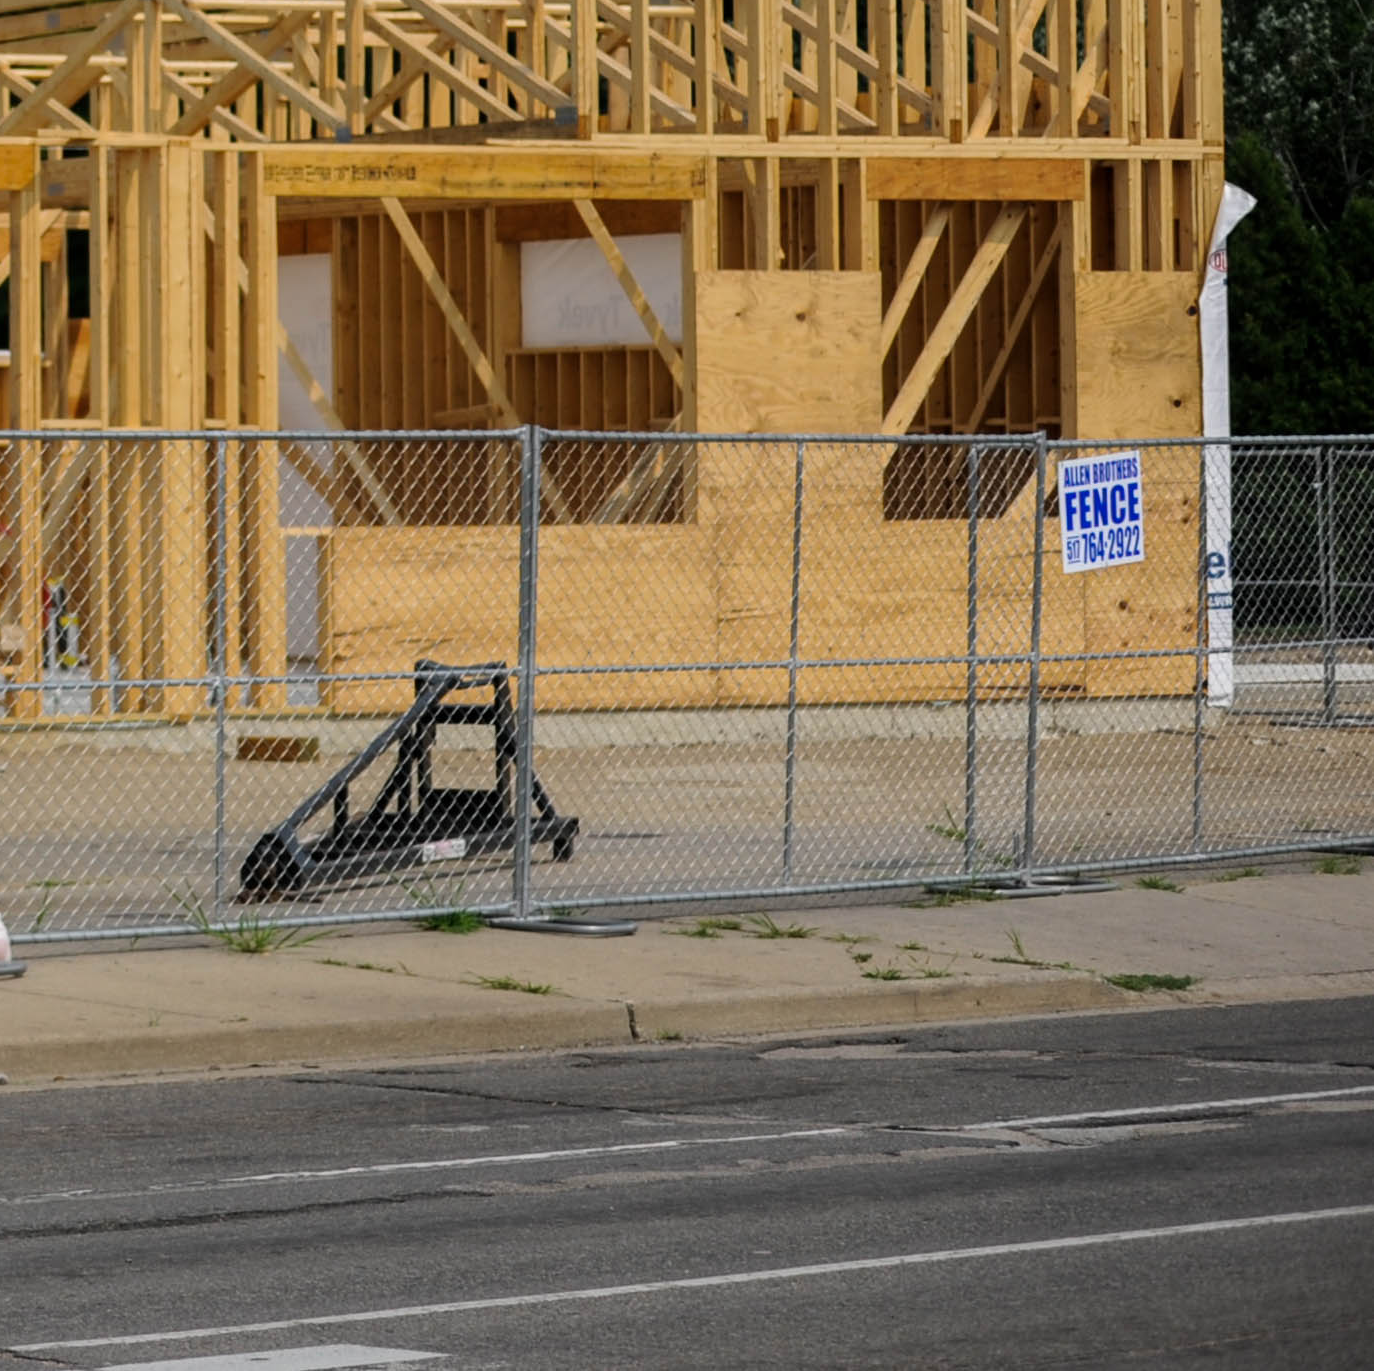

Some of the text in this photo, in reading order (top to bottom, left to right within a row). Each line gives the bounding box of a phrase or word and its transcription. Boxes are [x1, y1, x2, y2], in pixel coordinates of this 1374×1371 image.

[1064, 457, 1138, 488] ALLEN BROTHERS
[1064, 482, 1140, 532] FENCE
